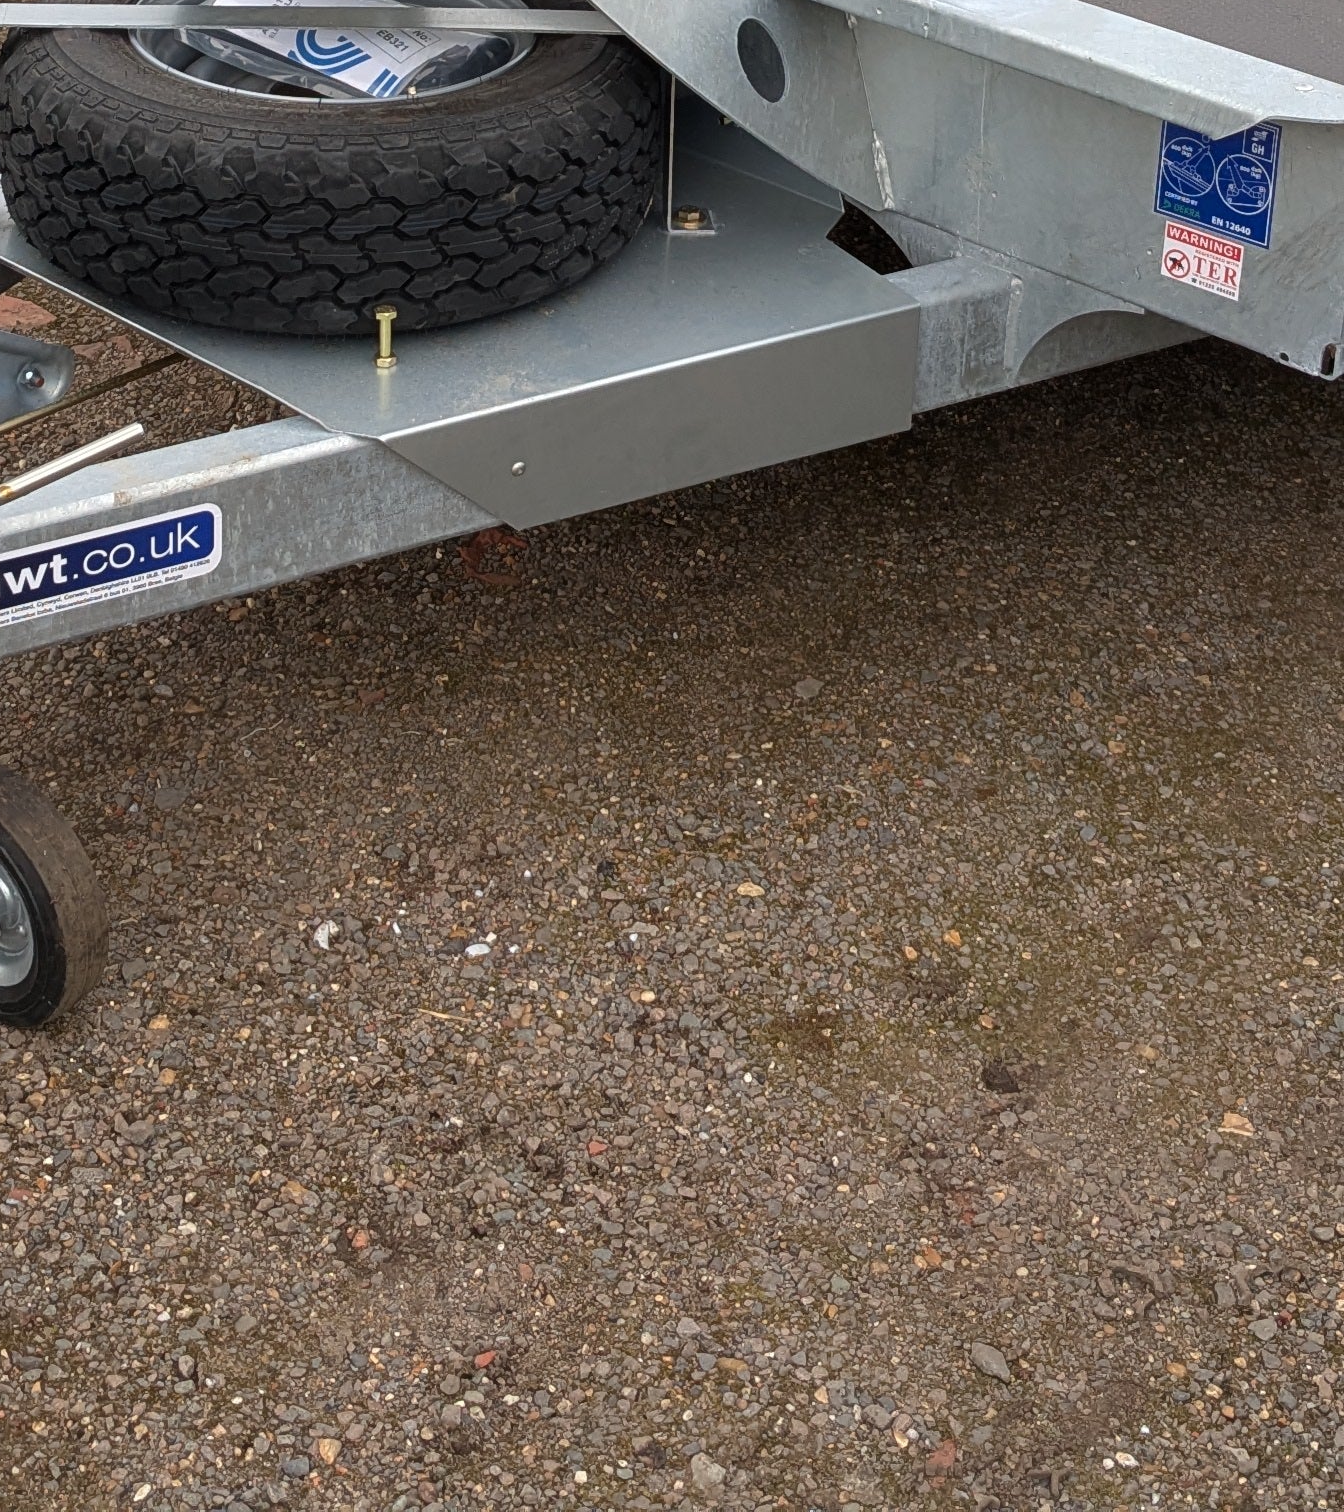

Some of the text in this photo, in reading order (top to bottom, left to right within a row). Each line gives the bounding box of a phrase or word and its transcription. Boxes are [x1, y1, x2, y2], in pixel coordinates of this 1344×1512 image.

[376, 30, 408, 52] EB321
[1251, 143, 1265, 156] GH
[1212, 216, 1252, 236] EN 12640
[1169, 226, 1239, 259] WARNING!
[1192, 255, 1238, 287] TER
